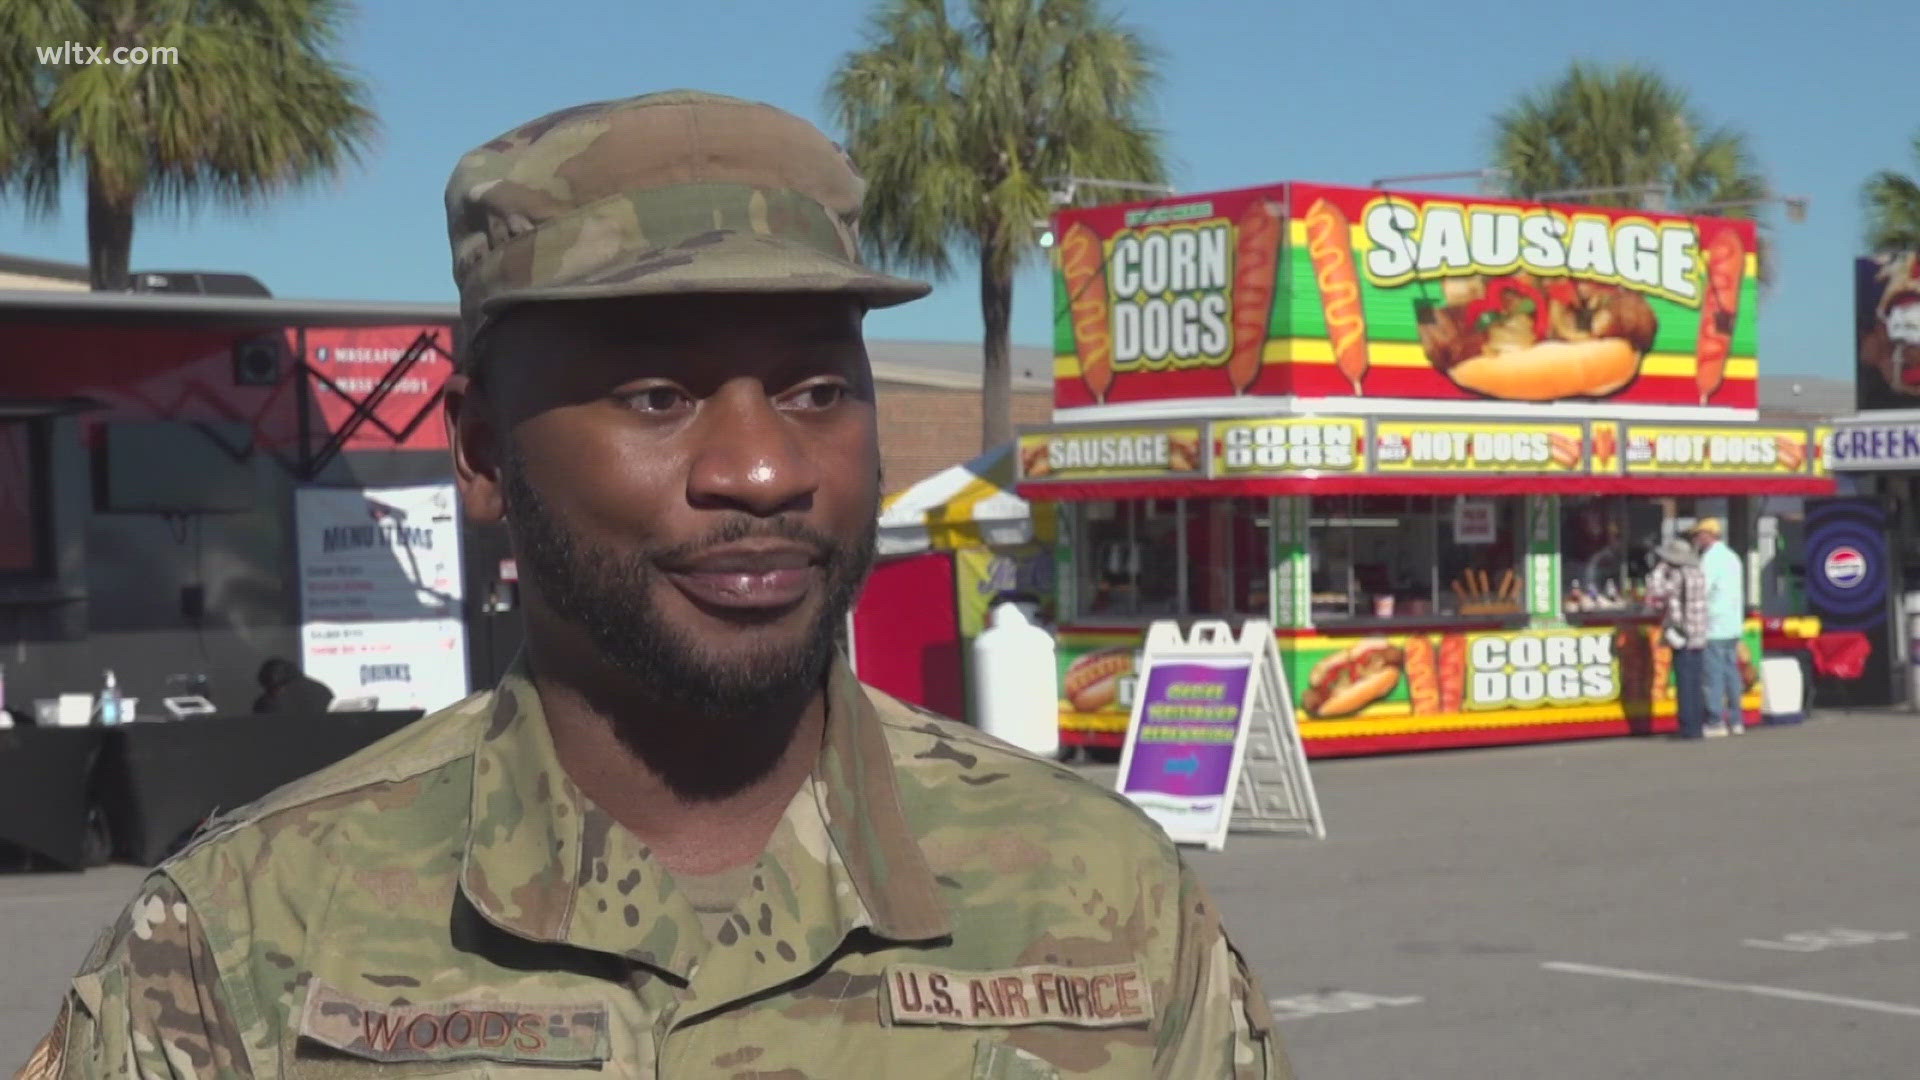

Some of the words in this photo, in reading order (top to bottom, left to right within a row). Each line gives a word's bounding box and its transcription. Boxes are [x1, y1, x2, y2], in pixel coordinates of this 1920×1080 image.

[1113, 227, 1227, 298] CORN
[1366, 203, 1697, 297] SAUSAGE
[1114, 293, 1228, 362] DOGS
[1050, 433, 1170, 469] SAUSAGE
[1226, 424, 1350, 446] CORN
[1411, 432, 1468, 461] HOT
[1473, 432, 1549, 462] DOGS
[1656, 434, 1707, 462] HOT
[1710, 435, 1776, 464] DOGS
[1834, 428, 1920, 459] GREEK
[1226, 444, 1352, 468] DOGS
[323, 525, 374, 553] MENU
[1472, 634, 1614, 670] CORN
[1473, 664, 1613, 701] DOGS
[895, 971, 963, 1017] U.S.
[968, 976, 1030, 1018] AIR
[1032, 970, 1143, 1018] FORCE
[363, 1009, 547, 1053] WOODS
